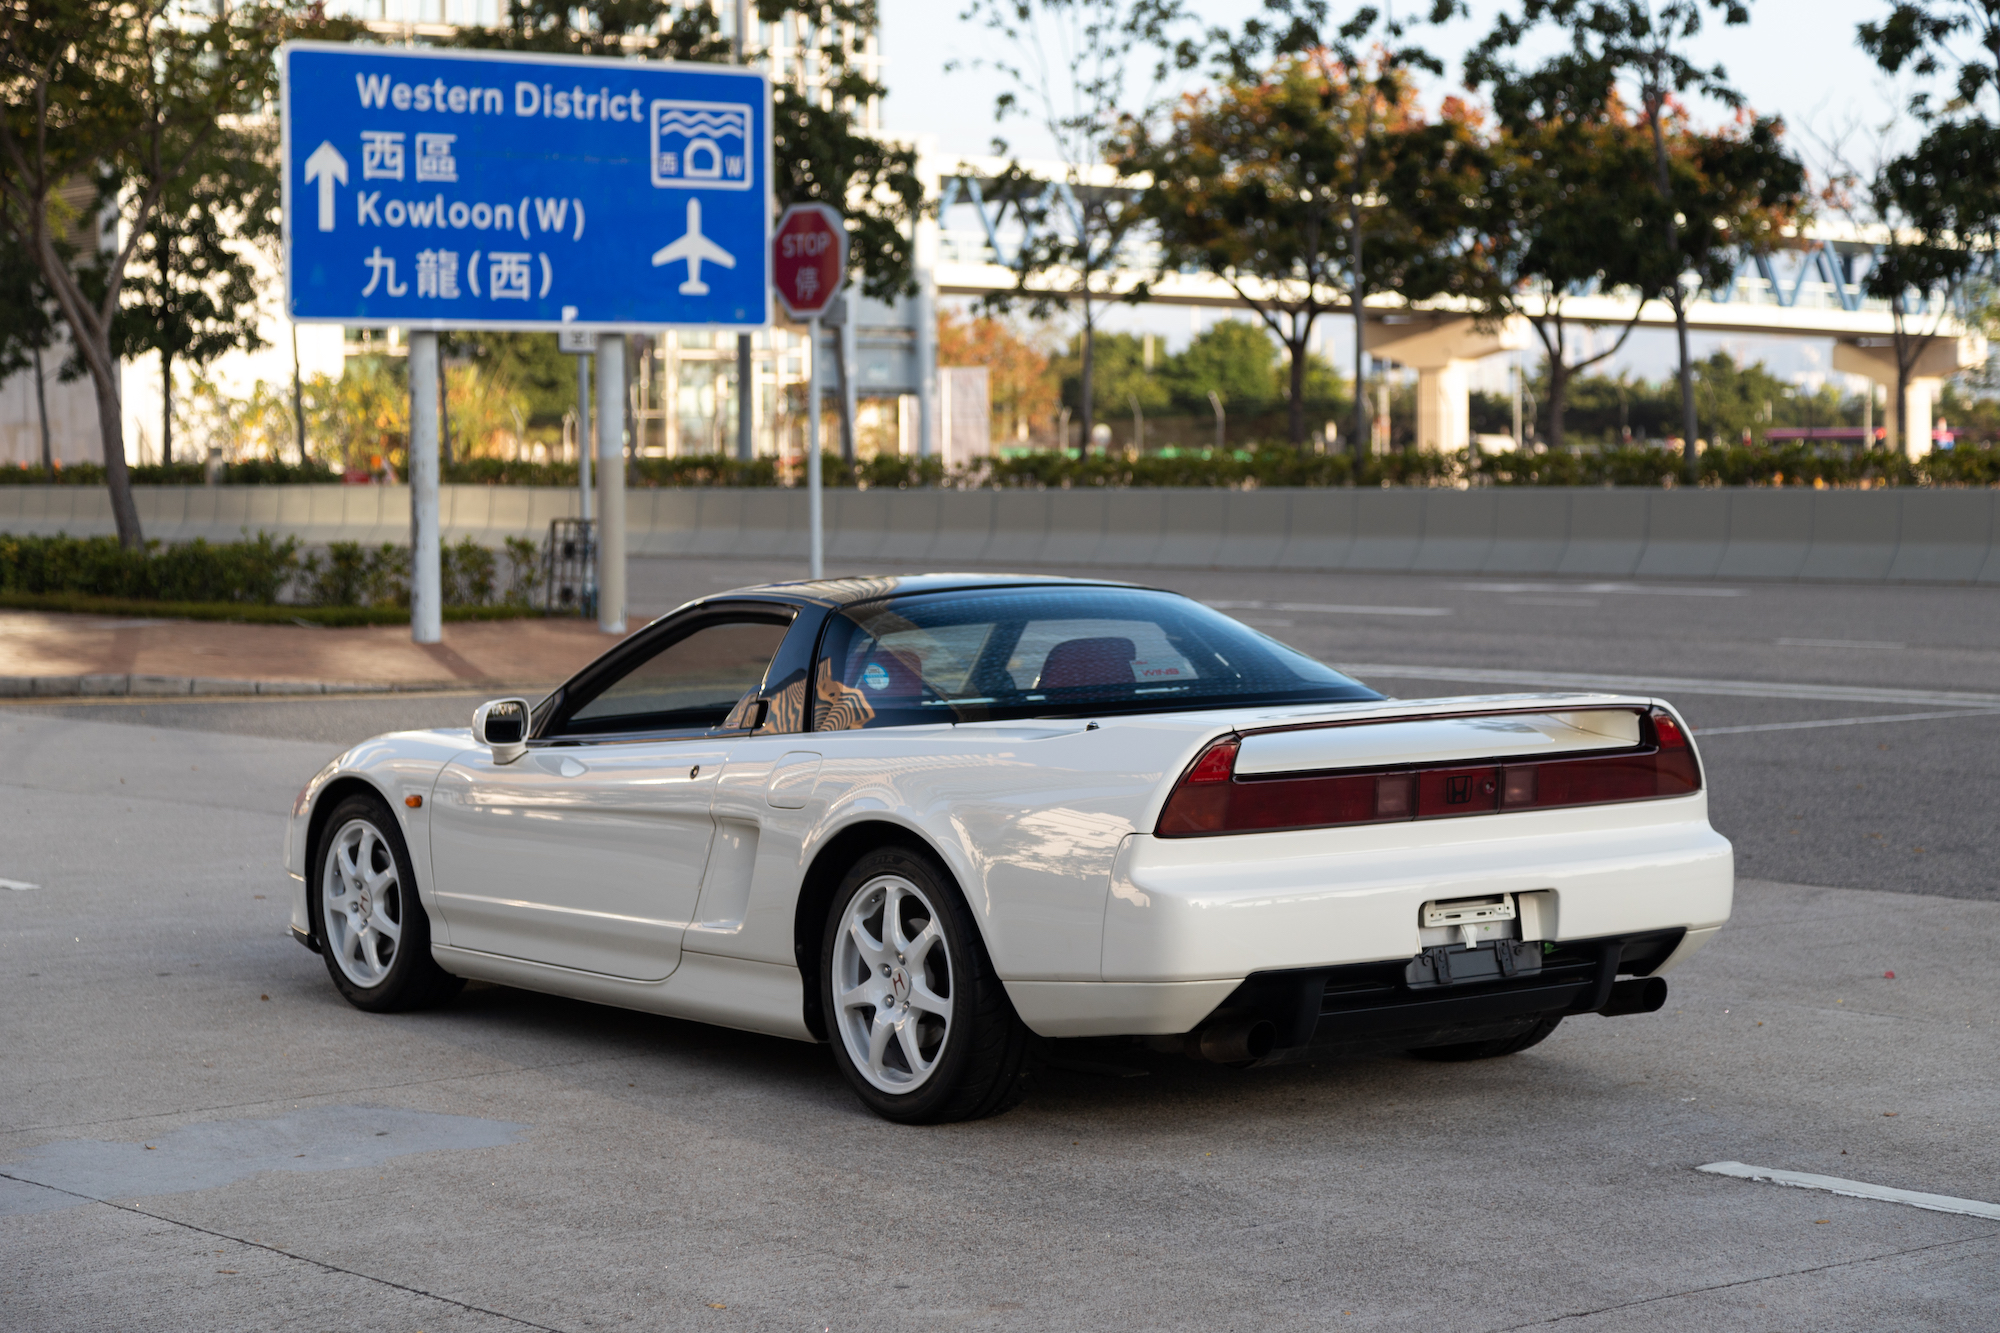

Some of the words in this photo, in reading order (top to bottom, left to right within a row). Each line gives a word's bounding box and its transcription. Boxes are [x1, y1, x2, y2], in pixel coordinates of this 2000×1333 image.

[355, 73, 503, 115] Western
[514, 81, 644, 123] District
[360, 130, 459, 183] 西區
[658, 151, 679, 176] 西
[724, 154, 744, 178] W
[356, 190, 586, 242] Kowloon(W)
[781, 231, 831, 258] STOP
[795, 266, 819, 300] 停
